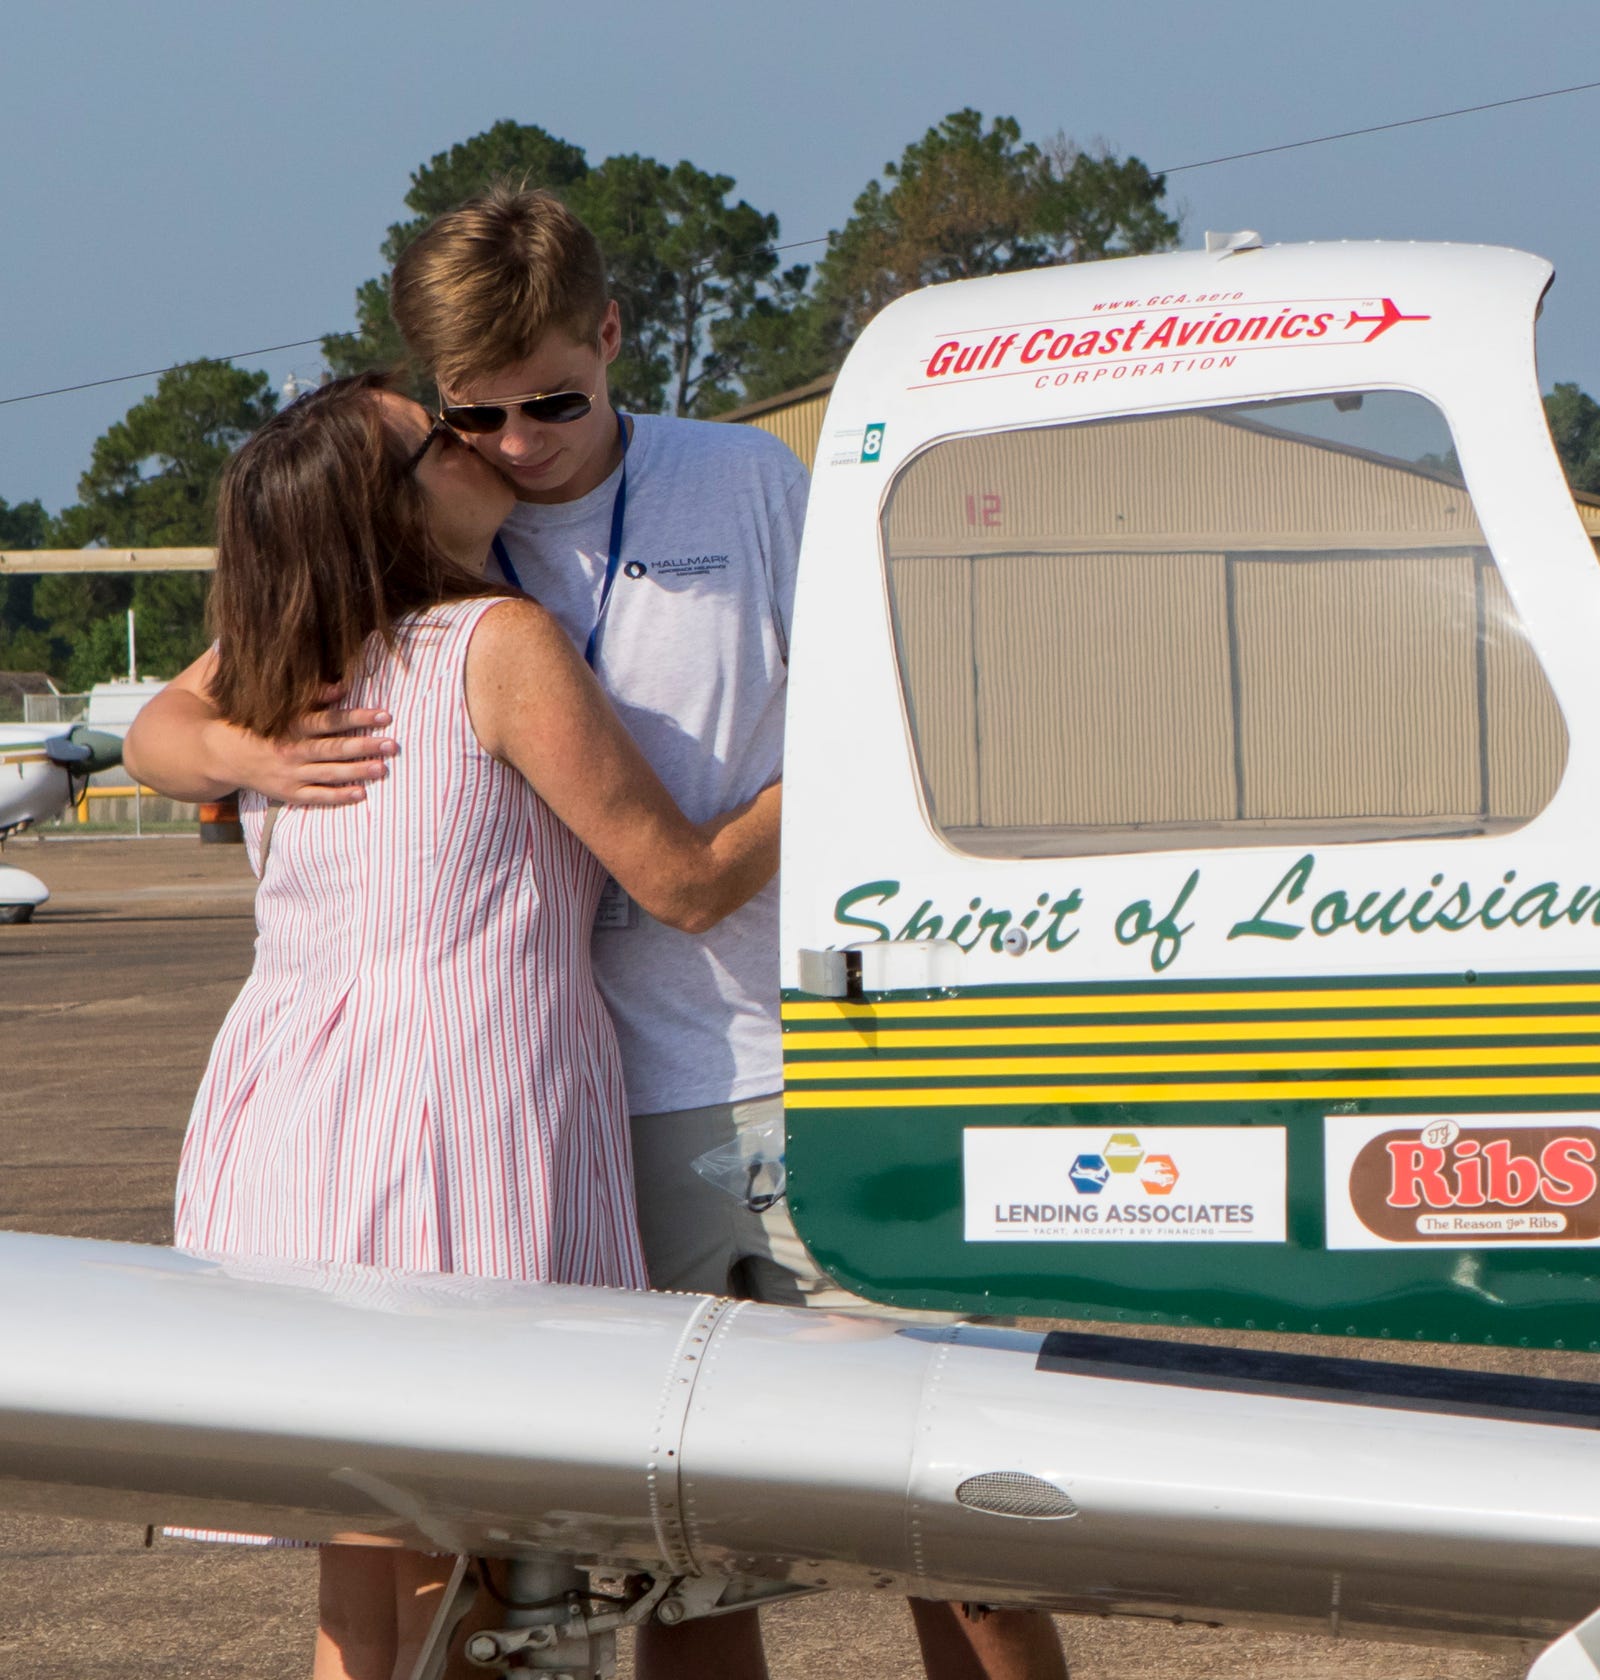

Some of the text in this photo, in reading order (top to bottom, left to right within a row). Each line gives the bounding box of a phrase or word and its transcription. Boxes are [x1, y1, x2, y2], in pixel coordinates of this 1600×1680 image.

[1092, 291, 1244, 311] www.GCA.aero
[926, 308, 1335, 378] Gulf Coast Avionics
[1035, 355, 1237, 389] CORPORATION
[864, 429, 881, 454] 8
[967, 495, 1002, 526] 12
[651, 555, 729, 568] HALLMARK
[832, 880, 1084, 954] Spirit
[1114, 868, 1197, 973] of
[995, 1204, 1254, 1223] LENDING ASSOCIATES
[1425, 1219, 1449, 1230] The
[1454, 1218, 1501, 1230] Reason
[1529, 1217, 1558, 1229] Ribs
[1034, 1228, 1069, 1236] YACHT,
[1140, 1227, 1153, 1235] RV
[1158, 1227, 1215, 1235] FINANCING
